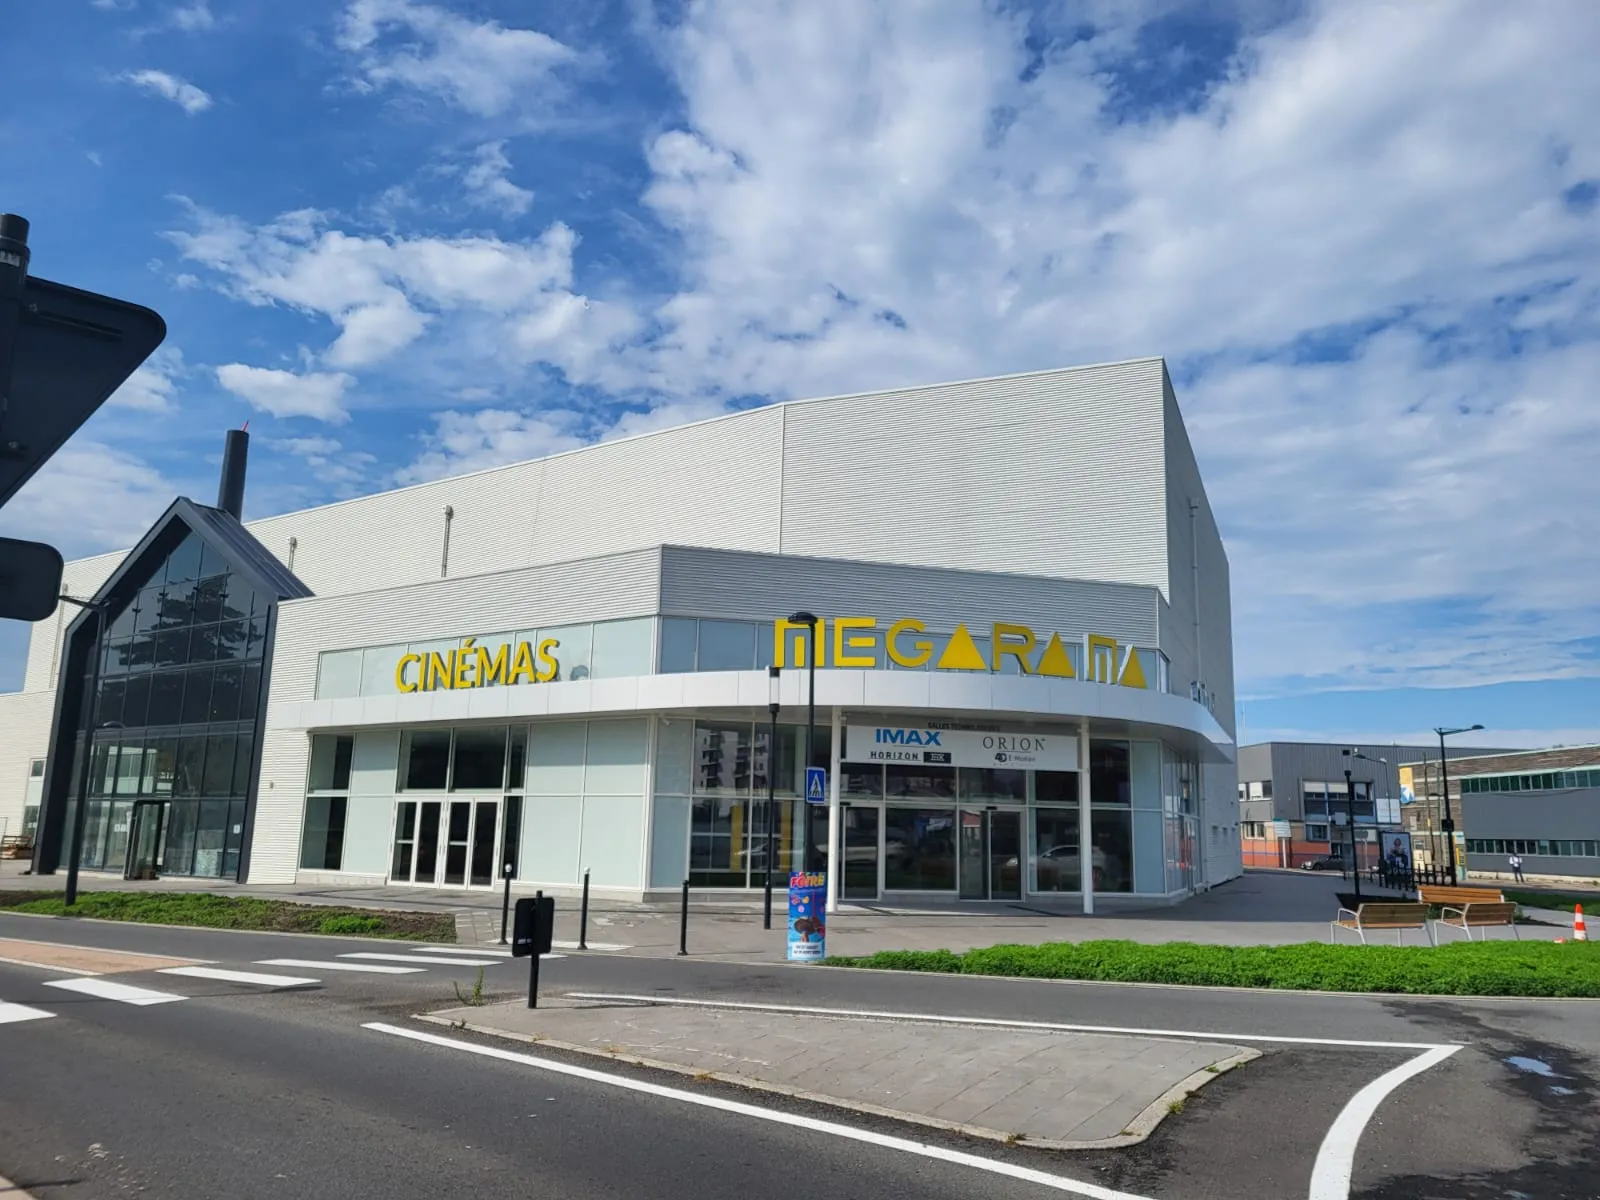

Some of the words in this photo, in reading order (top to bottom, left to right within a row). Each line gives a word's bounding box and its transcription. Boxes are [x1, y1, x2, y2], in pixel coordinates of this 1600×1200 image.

[774, 617, 1149, 689] MEGARAMA
[395, 637, 560, 694] CINÉMAS
[876, 728, 941, 746] IMAX
[982, 736, 1045, 751] ORION
[870, 750, 919, 760] HORIZON
